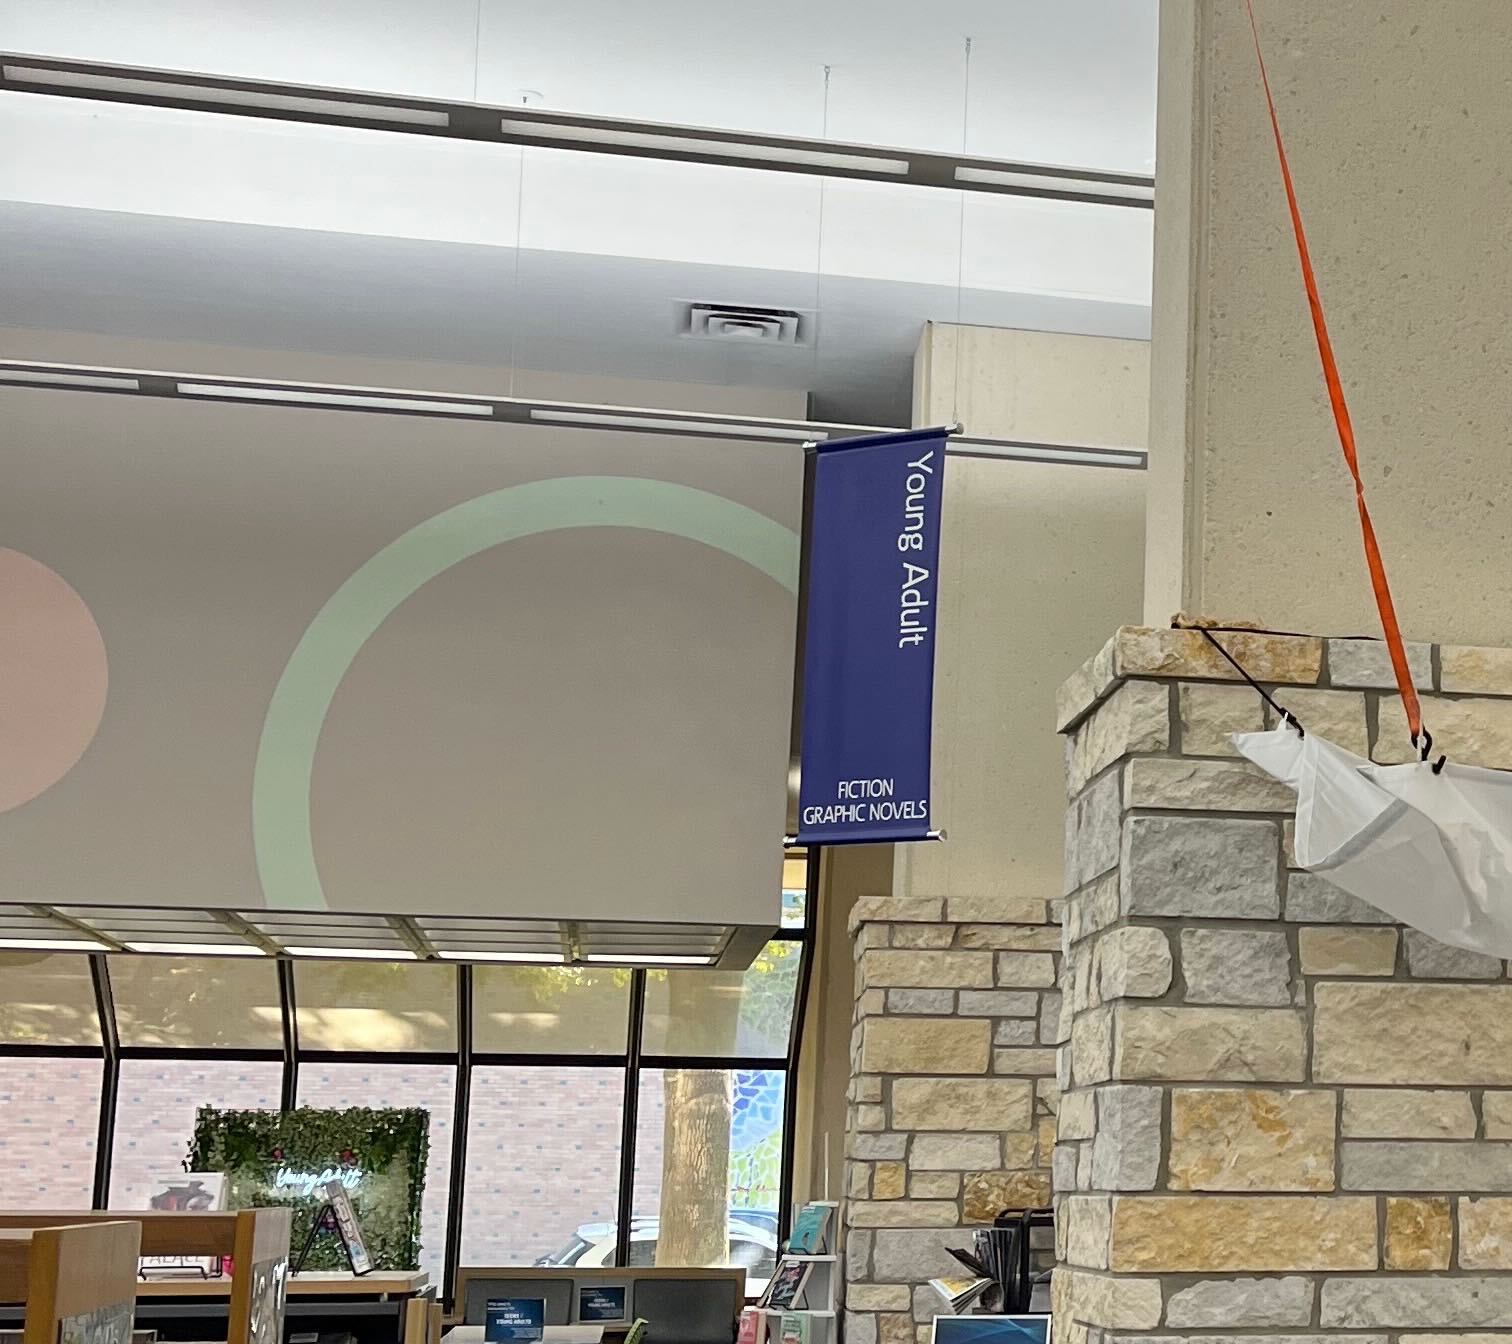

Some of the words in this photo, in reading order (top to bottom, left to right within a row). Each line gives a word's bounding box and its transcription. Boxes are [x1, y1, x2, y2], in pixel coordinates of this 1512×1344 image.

[898, 450, 933, 552] Young
[899, 562, 929, 649] Adult
[803, 802, 866, 825] GRAPHIC
[868, 799, 927, 822] NOVELS
[837, 778, 894, 800] FICTION
